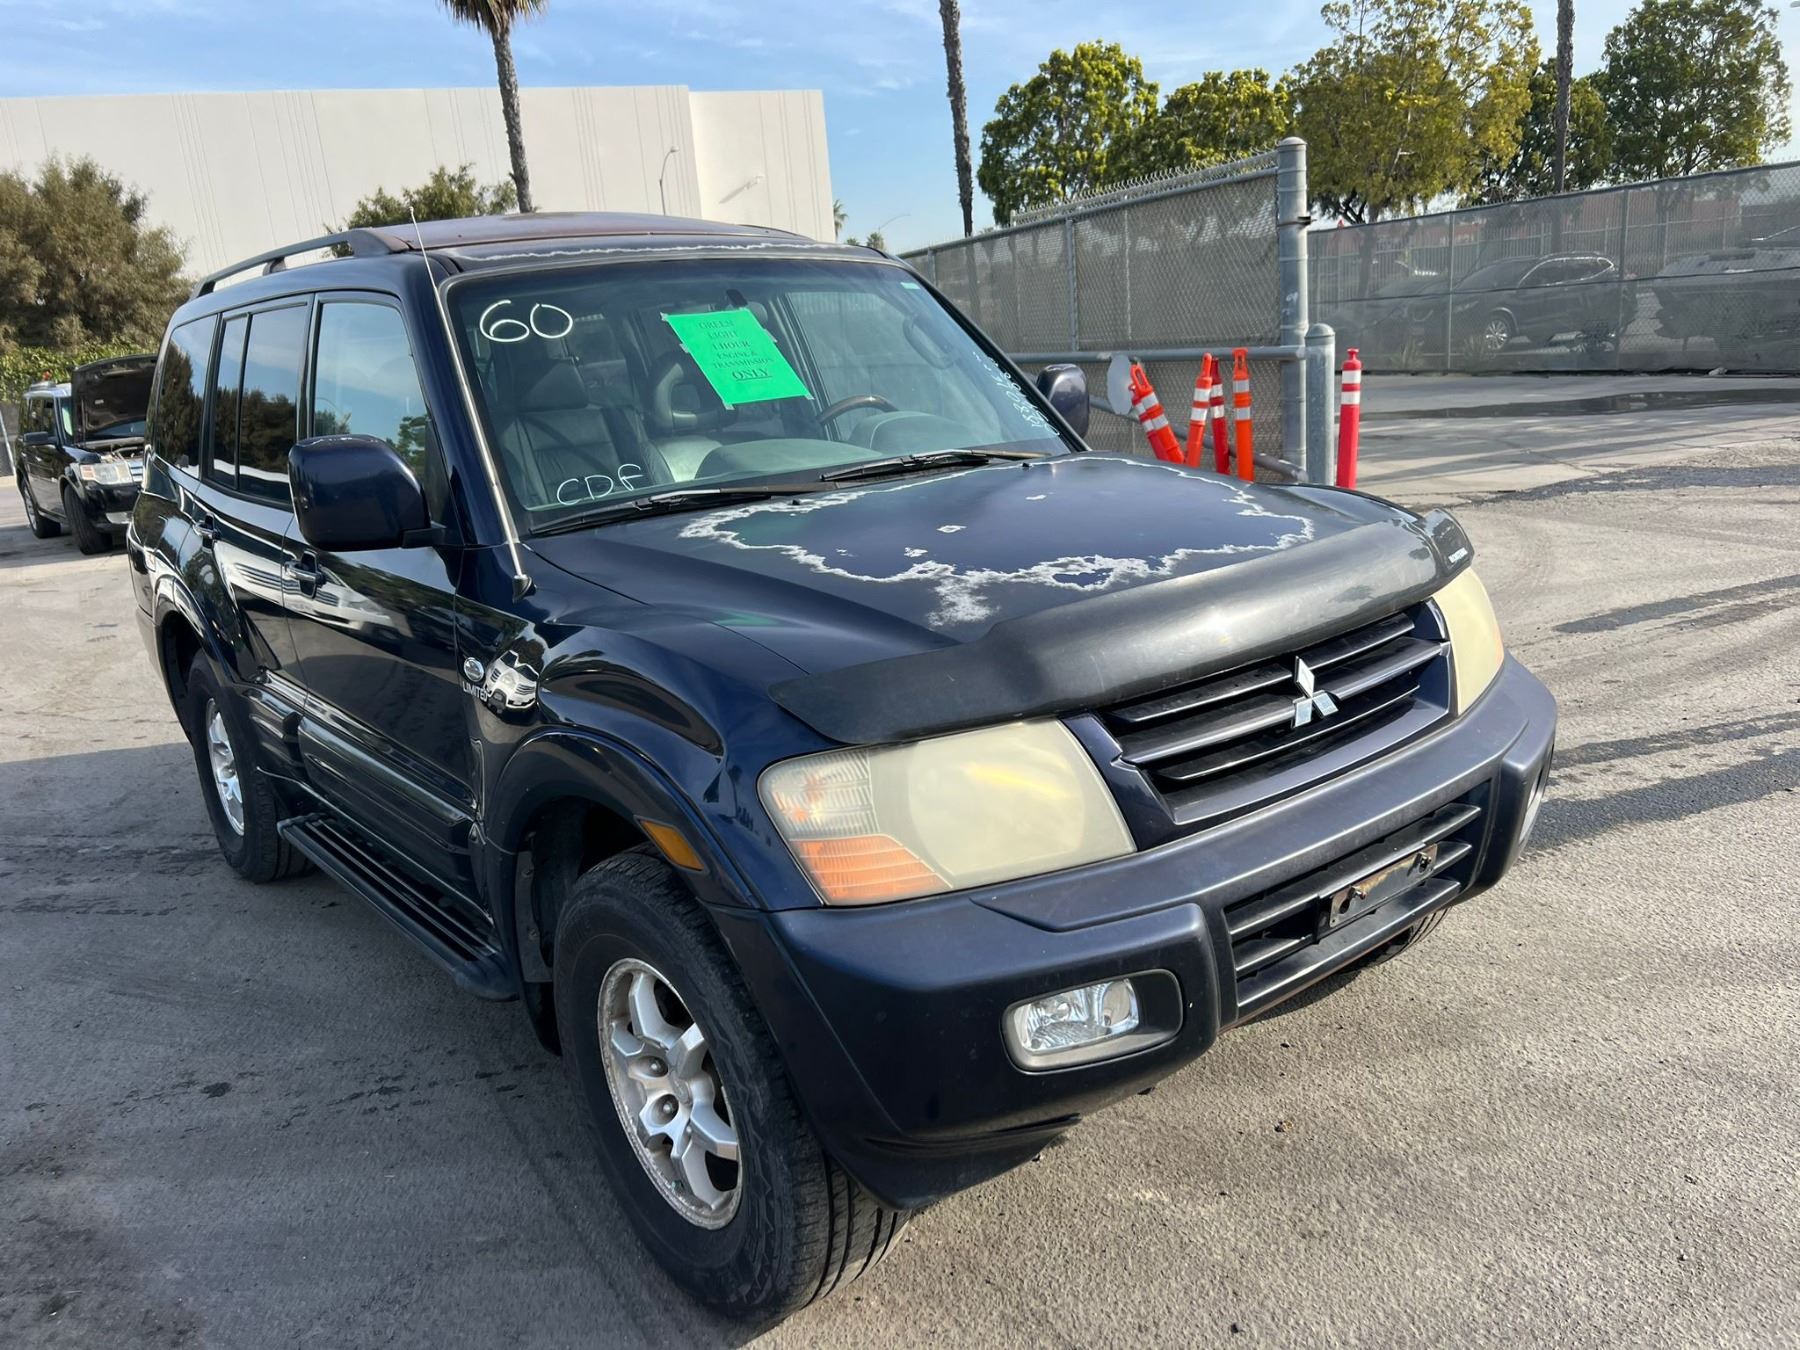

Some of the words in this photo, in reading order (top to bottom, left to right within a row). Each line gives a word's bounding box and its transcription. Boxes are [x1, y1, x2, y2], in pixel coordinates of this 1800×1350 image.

[480, 299, 573, 342] 60
[698, 319, 735, 329] GREEN
[714, 357, 774, 369] TRANSMISSION
[732, 368, 769, 380] ONLY
[462, 680, 488, 702] LIMITED
